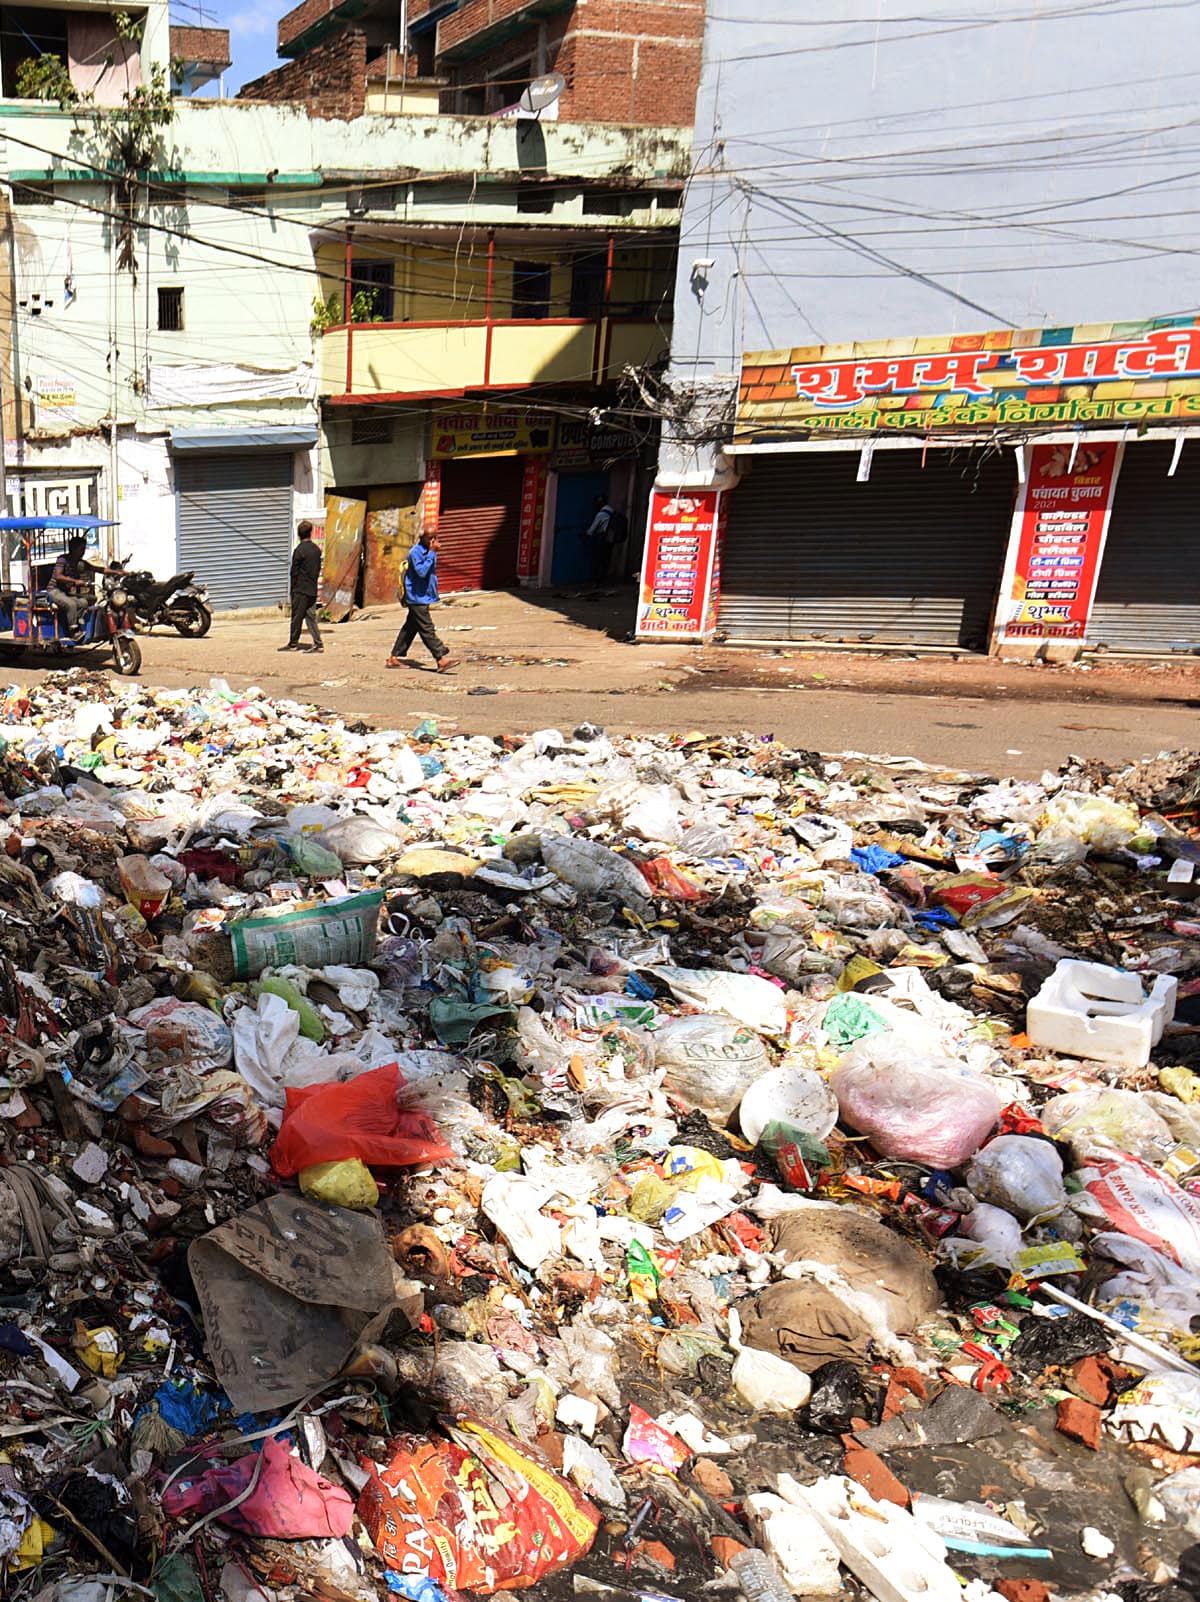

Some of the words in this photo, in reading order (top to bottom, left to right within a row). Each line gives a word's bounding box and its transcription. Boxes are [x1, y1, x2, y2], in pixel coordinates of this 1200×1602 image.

[791, 350, 999, 408] शुभम्
[1117, 393, 1177, 418] एवं
[1032, 485, 1068, 500] पंचायत
[1071, 486, 1103, 501] चुनाव
[1034, 500, 1057, 509] 2021
[655, 607, 688, 618] शुभम्
[1028, 605, 1071, 619] शुभम्
[640, 618, 668, 630] शादी
[1007, 622, 1043, 637] शादी
[1048, 621, 1080, 637] कार्ड
